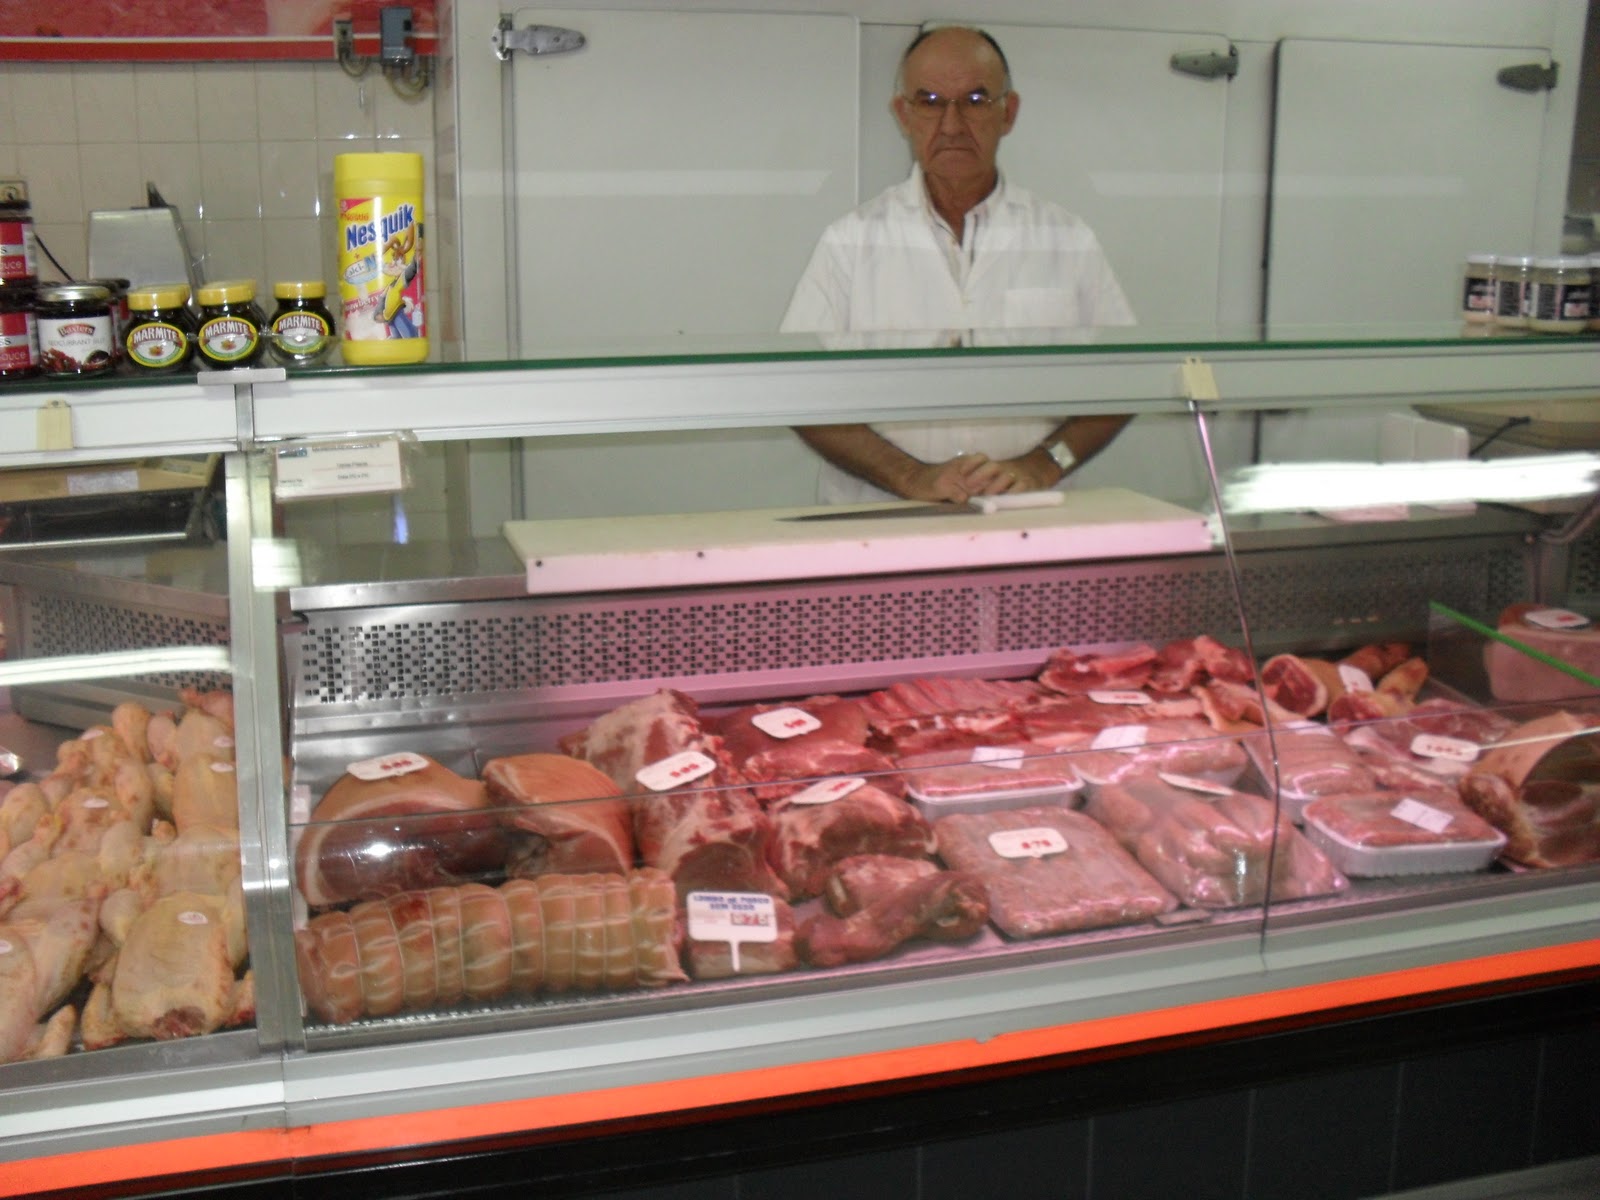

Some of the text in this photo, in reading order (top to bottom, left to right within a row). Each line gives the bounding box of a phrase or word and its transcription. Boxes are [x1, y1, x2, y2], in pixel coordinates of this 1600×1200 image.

[346, 204, 413, 251] Nesquik
[60, 324, 94, 336] Baxters
[205, 321, 249, 337] MARMITE
[278, 315, 322, 331] MARMITE
[133, 326, 177, 343] MARMITE
